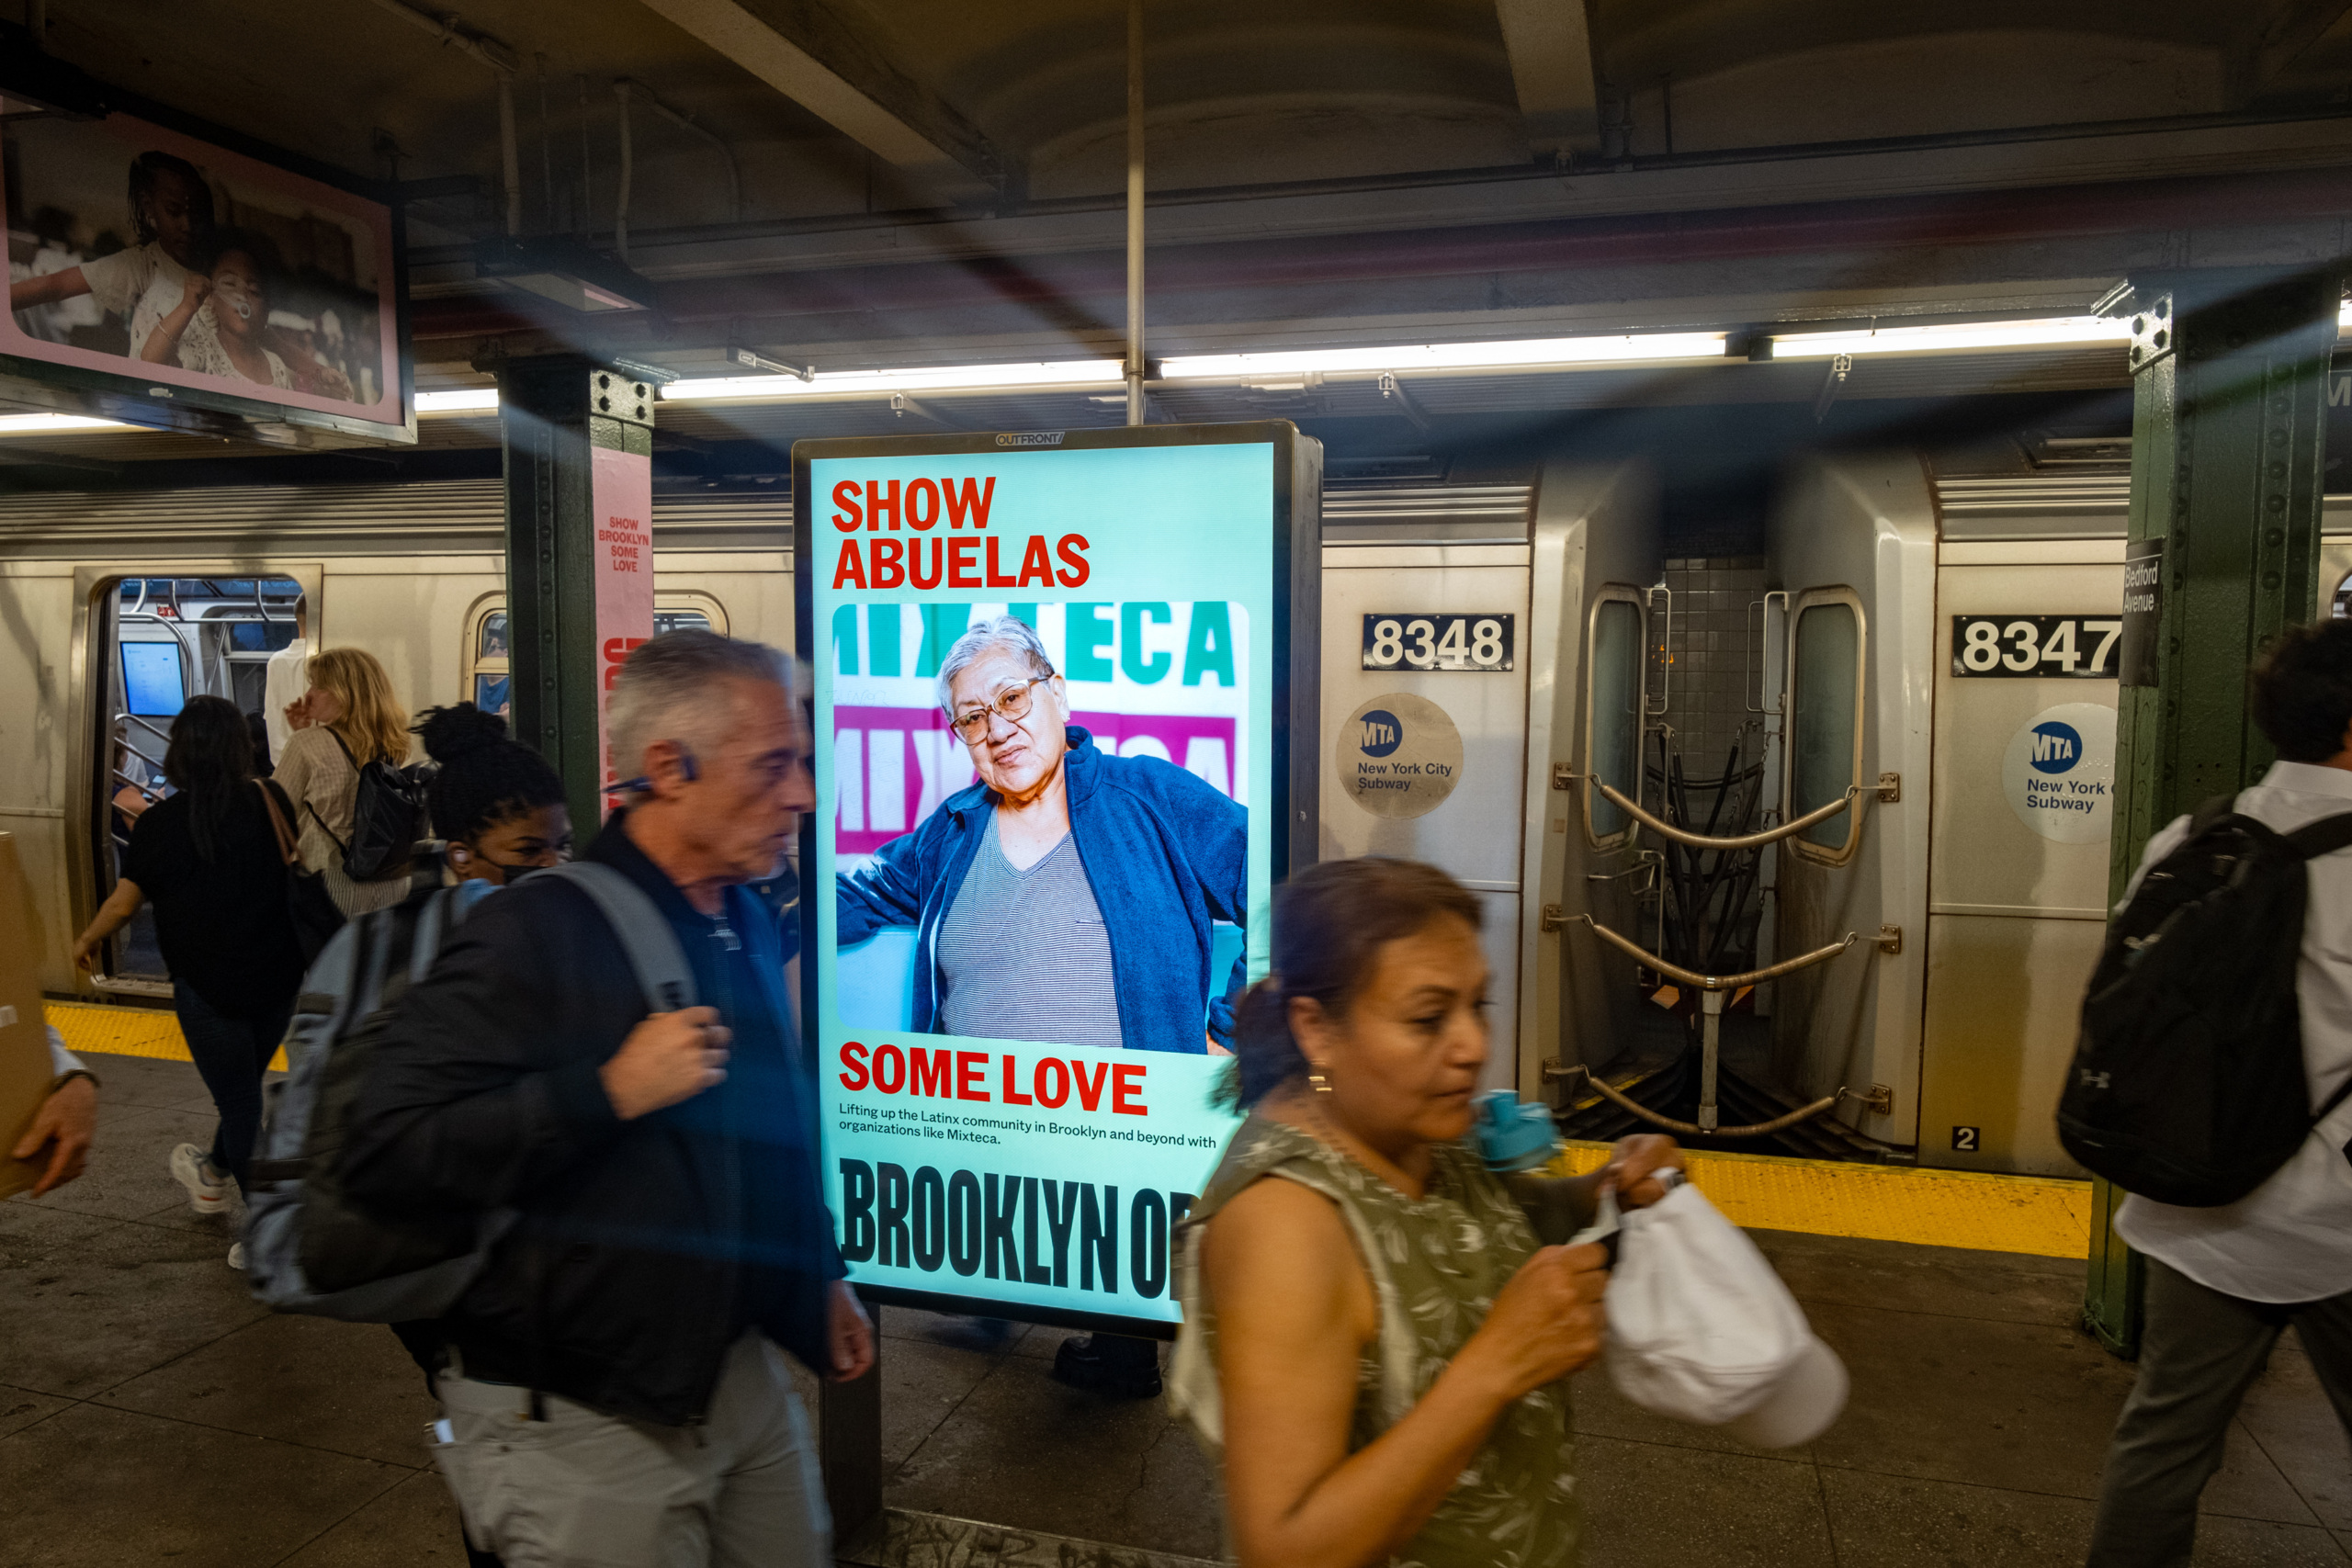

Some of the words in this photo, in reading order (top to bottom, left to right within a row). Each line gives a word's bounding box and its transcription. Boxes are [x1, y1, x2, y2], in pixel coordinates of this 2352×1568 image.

[831, 477, 996, 533] SHOW
[609, 516, 639, 530] SHOW
[598, 530, 650, 546] BROOKLYN
[611, 546, 639, 558] SOME
[831, 534, 1091, 590] ABUELAS
[613, 559, 638, 572] LOVE
[2125, 560, 2158, 588] Bedford
[2123, 591, 2154, 614] Avenue
[1372, 619, 1503, 666] 8348
[1962, 620, 2123, 672] 8347
[1361, 720, 1396, 748] MTA
[2031, 732, 2074, 763] MTA
[1358, 762, 1387, 774] New
[1392, 762, 1421, 775] York
[1425, 762, 1453, 777] City
[1358, 778, 1411, 792] Subway
[2028, 779, 2064, 793] New
[2068, 780, 2106, 795] York
[2027, 795, 2095, 814] Subway
[839, 1042, 990, 1102] SOME
[1002, 1055, 1148, 1116] LOVE
[839, 1102, 878, 1120] Lifting
[881, 1109, 896, 1121] up
[899, 1108, 918, 1121] the
[921, 1111, 960, 1124] Latinx
[962, 1117, 1033, 1134] community
[1035, 1121, 1046, 1133] in
[1049, 1122, 1106, 1140] Brooklyn
[1110, 1129, 1134, 1141] and
[1136, 1130, 1185, 1145] beyond
[1187, 1135, 1216, 1148] with
[839, 1120, 921, 1136] organizations
[923, 1126, 944, 1139] like
[947, 1129, 1001, 1145] Mixteca.
[1957, 1127, 1974, 1150] 2
[839, 1157, 1119, 1294] BROOKLYN
